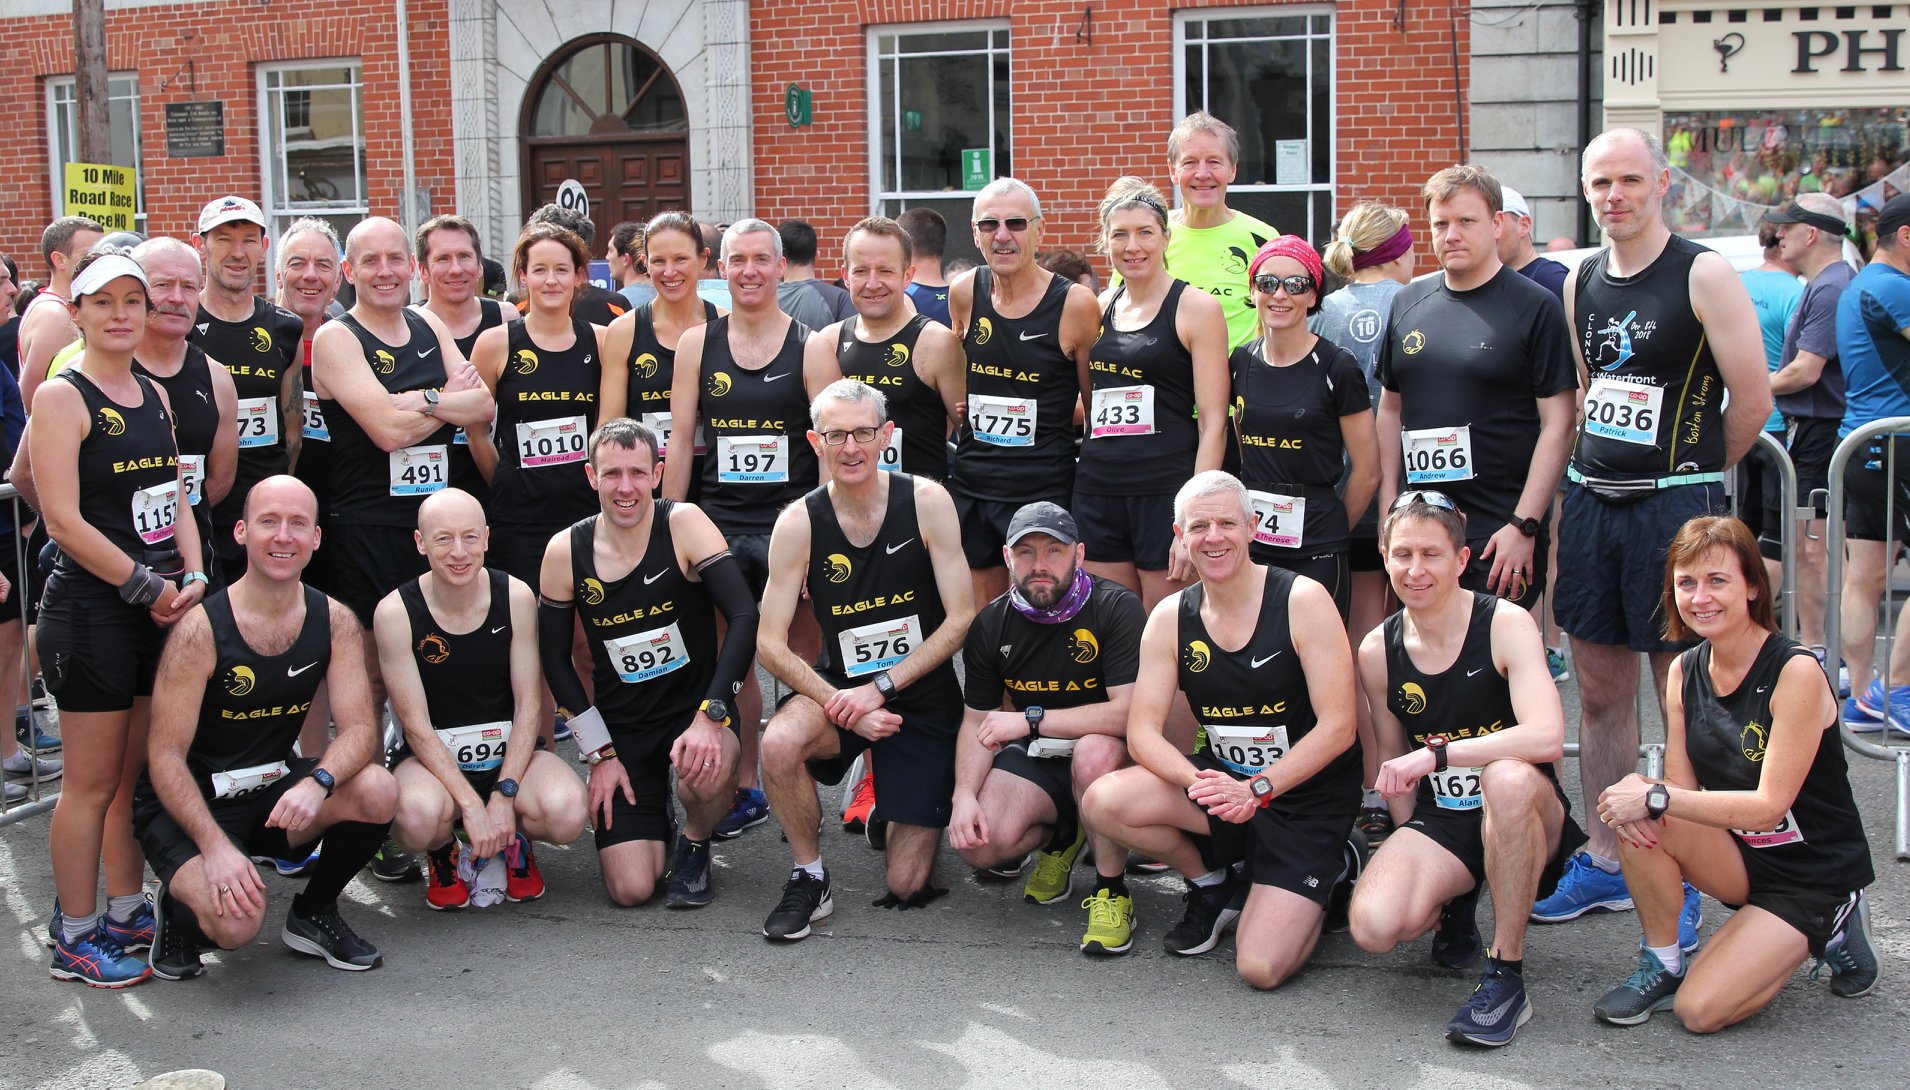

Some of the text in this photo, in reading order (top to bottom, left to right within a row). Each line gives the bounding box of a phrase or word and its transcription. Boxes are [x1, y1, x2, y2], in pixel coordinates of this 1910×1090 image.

[82, 168, 125, 186] 10 Mile
[69, 189, 132, 209] Road Race
[114, 213, 126, 230] HQ
[1210, 287, 1233, 296] AC
[1357, 321, 1375, 337] 10
[1630, 320, 1657, 331] Dec 8th
[1634, 331, 1652, 340] 2018
[224, 365, 276, 379] GLE AC
[971, 362, 1041, 383] EAGLE AC
[1089, 360, 1143, 379] AGLE AC
[879, 375, 903, 386] AC
[1597, 372, 1657, 385] Waterfront
[518, 391, 594, 402] EAGLE AC
[641, 390, 672, 401] EAG
[1096, 405, 1140, 426] 433
[1586, 399, 1653, 431] 2036
[1684, 374, 1714, 445] Boston Strong
[711, 417, 784, 430] EAGLE AC
[972, 413, 1032, 437] 1775
[1106, 426, 1125, 434] Olive
[1599, 425, 1628, 438] Patrick
[523, 434, 584, 458] 1010
[986, 435, 1012, 444] Richard
[1280, 439, 1302, 450] AC
[112, 456, 163, 474] EAGLE
[540, 454, 570, 464] Mairead
[729, 454, 776, 473] 197
[1406, 447, 1467, 472] 1066
[401, 464, 443, 485] 491
[739, 474, 765, 482] Darren
[1419, 472, 1446, 480] Andrew
[1260, 533, 1290, 544] Therese
[832, 590, 915, 616] EAGLE AC
[592, 600, 674, 627] EAGLE AC
[855, 636, 910, 663] 576
[621, 646, 676, 673] 892
[876, 660, 894, 669] Tom
[638, 666, 668, 680] Damian
[1004, 679, 1060, 692] EAGLE
[221, 701, 311, 720] EAGLE AC
[1202, 700, 1287, 718] EAGLE AC
[1476, 719, 1504, 737] AC
[457, 741, 507, 763] 694
[1213, 742, 1285, 768] 1033
[462, 762, 486, 770] Derek
[1239, 766, 1262, 775] David
[1458, 798, 1479, 807] Alan
[1744, 837, 1773, 845] ances
